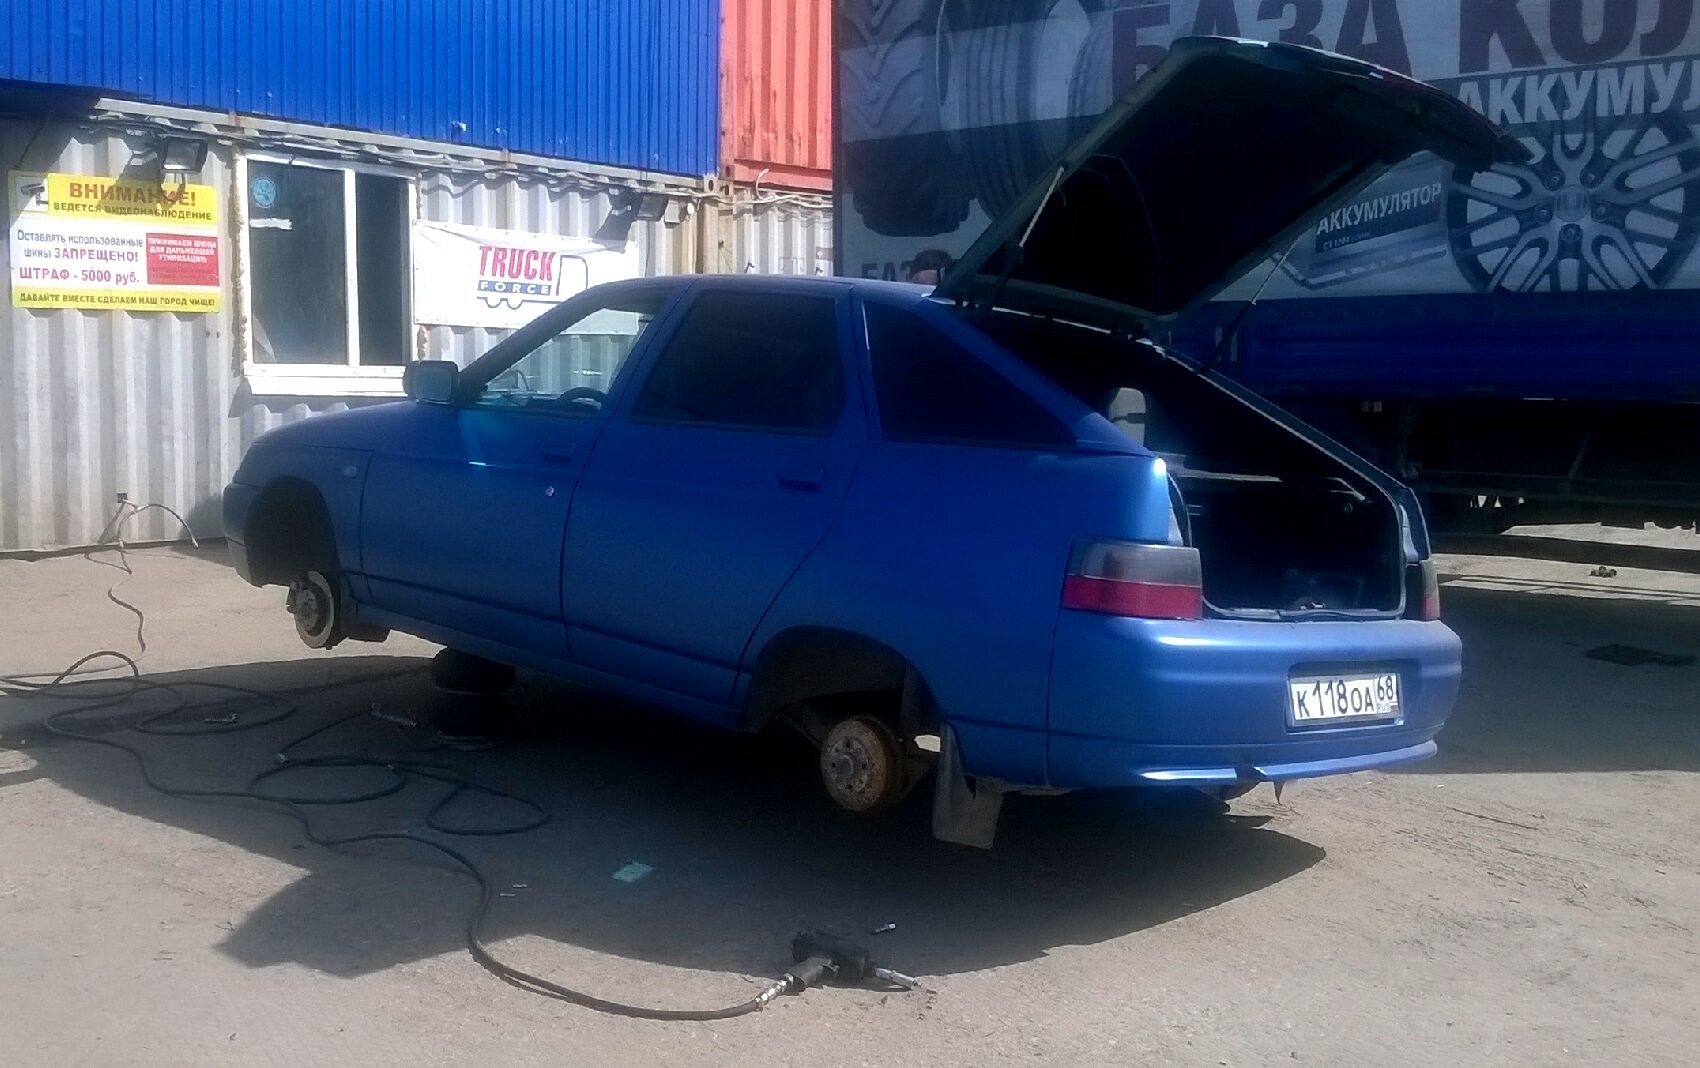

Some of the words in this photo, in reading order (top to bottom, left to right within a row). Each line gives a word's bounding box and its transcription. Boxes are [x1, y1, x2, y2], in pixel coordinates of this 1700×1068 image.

[54, 202, 101, 212] ВЕДЕТСЯ
[104, 205, 212, 220] ВИДЕОНАБЛЮДЕНИЕ
[1316, 183, 1442, 236] АККУМУЛЯТОР
[17, 229, 66, 243] Оставлять
[68, 235, 143, 247] использованные
[24, 248, 51, 258] шины
[54, 247, 138, 262] ЗАПРЕЩЕНО!
[478, 245, 556, 281] TRUCK
[19, 267, 70, 280] ШТРАФ
[81, 269, 111, 282] 5000
[116, 271, 139, 285] руб.
[480, 281, 550, 295] FORCE
[20, 292, 60, 302] ДАВАЙТЕ
[62, 294, 95, 303] ВМЕСТЕ
[97, 296, 137, 305] СДЕЛАЕМ
[139, 297, 158, 305] НАШ
[160, 298, 187, 306] ГОРОД
[189, 299, 215, 307] ЧИЩЕ!
